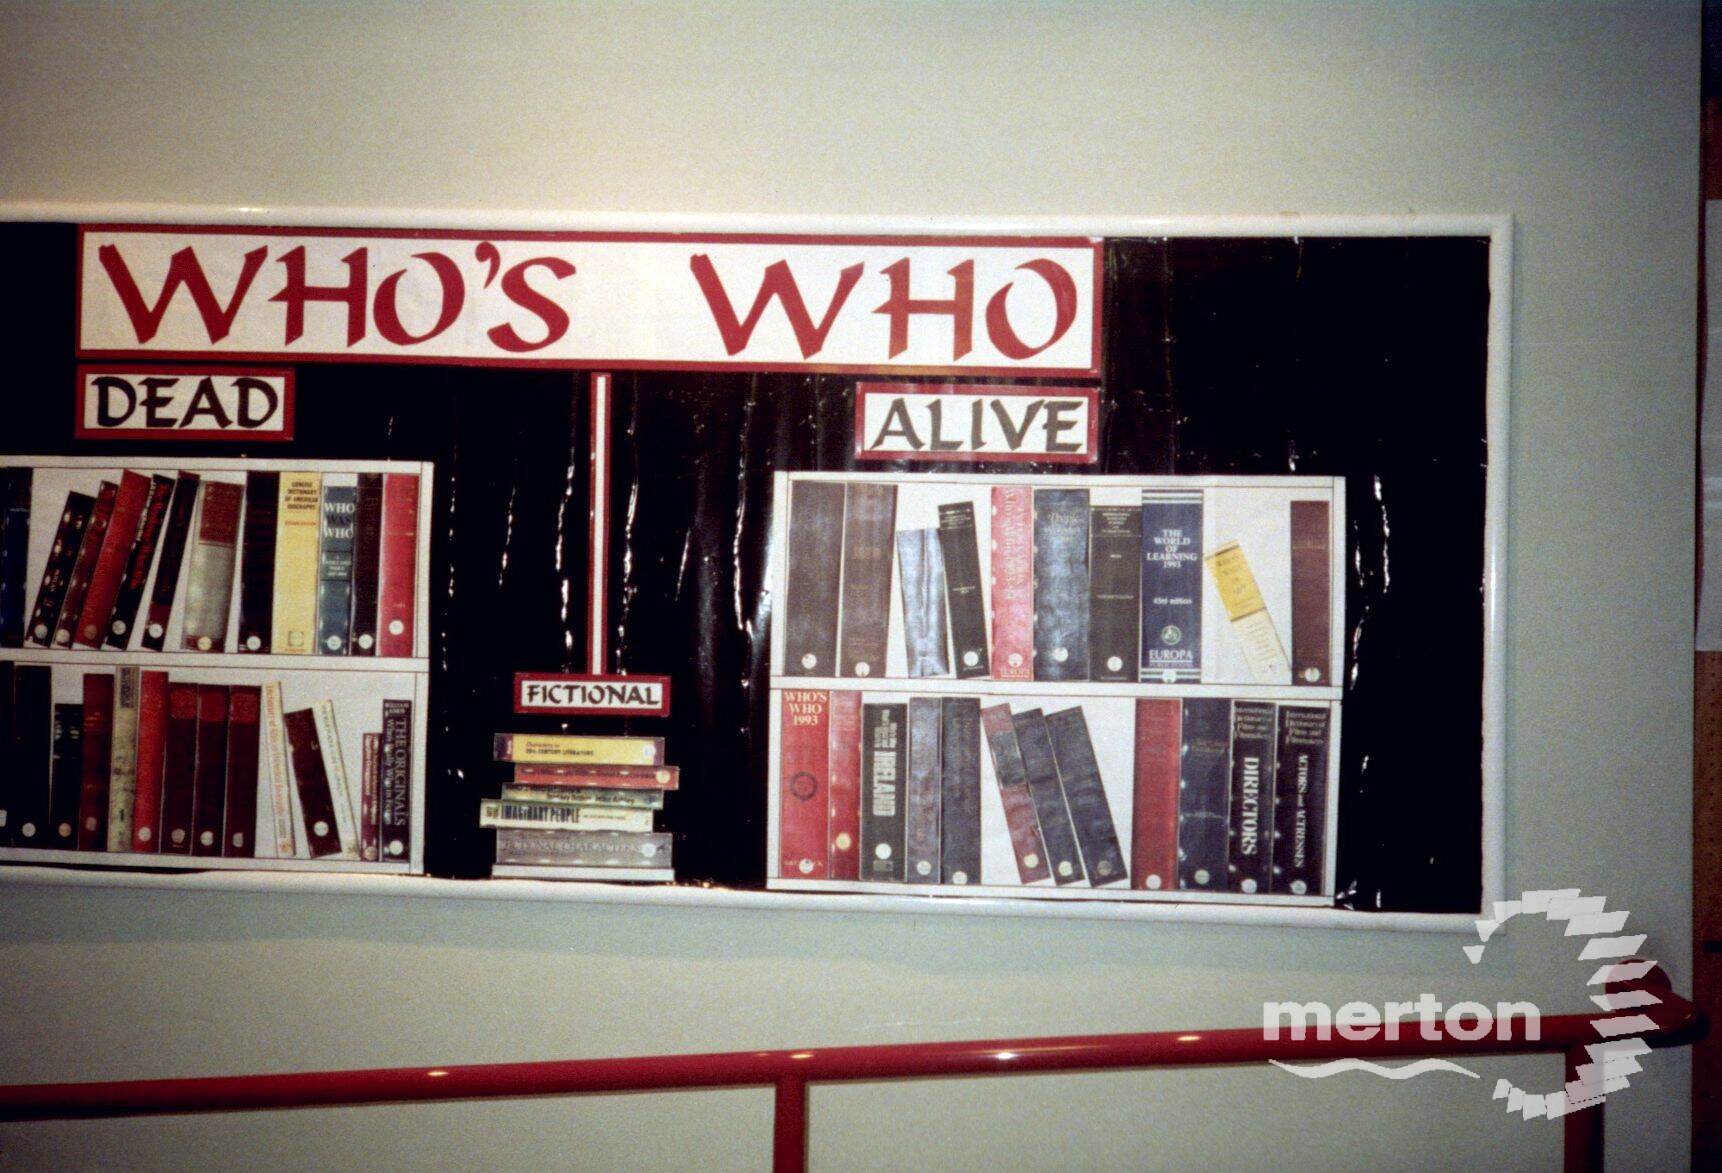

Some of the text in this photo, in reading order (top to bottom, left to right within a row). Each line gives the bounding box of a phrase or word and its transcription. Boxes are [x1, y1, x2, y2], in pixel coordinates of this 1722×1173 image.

[98, 241, 1078, 361] WHO'S WHO
[91, 376, 279, 428] DEAD
[869, 397, 1084, 453] ALIVE
[324, 502, 355, 514] WHO
[323, 527, 354, 539] WHO
[1162, 528, 1184, 538] THE
[1153, 537, 1191, 546] WORLD
[1164, 545, 1178, 553] OF
[1146, 552, 1198, 562] LEARNING
[1149, 650, 1194, 660] EUROPA
[527, 684, 660, 706] FICTIONAL
[785, 691, 827, 702] WHO'S
[789, 703, 822, 714] WHO
[793, 715, 818, 726] 1993
[395, 718, 407, 748] THE
[1298, 754, 1309, 794] ACTORS
[394, 749, 407, 826] ORIGINALS
[1241, 757, 1260, 856] DIRECTORS
